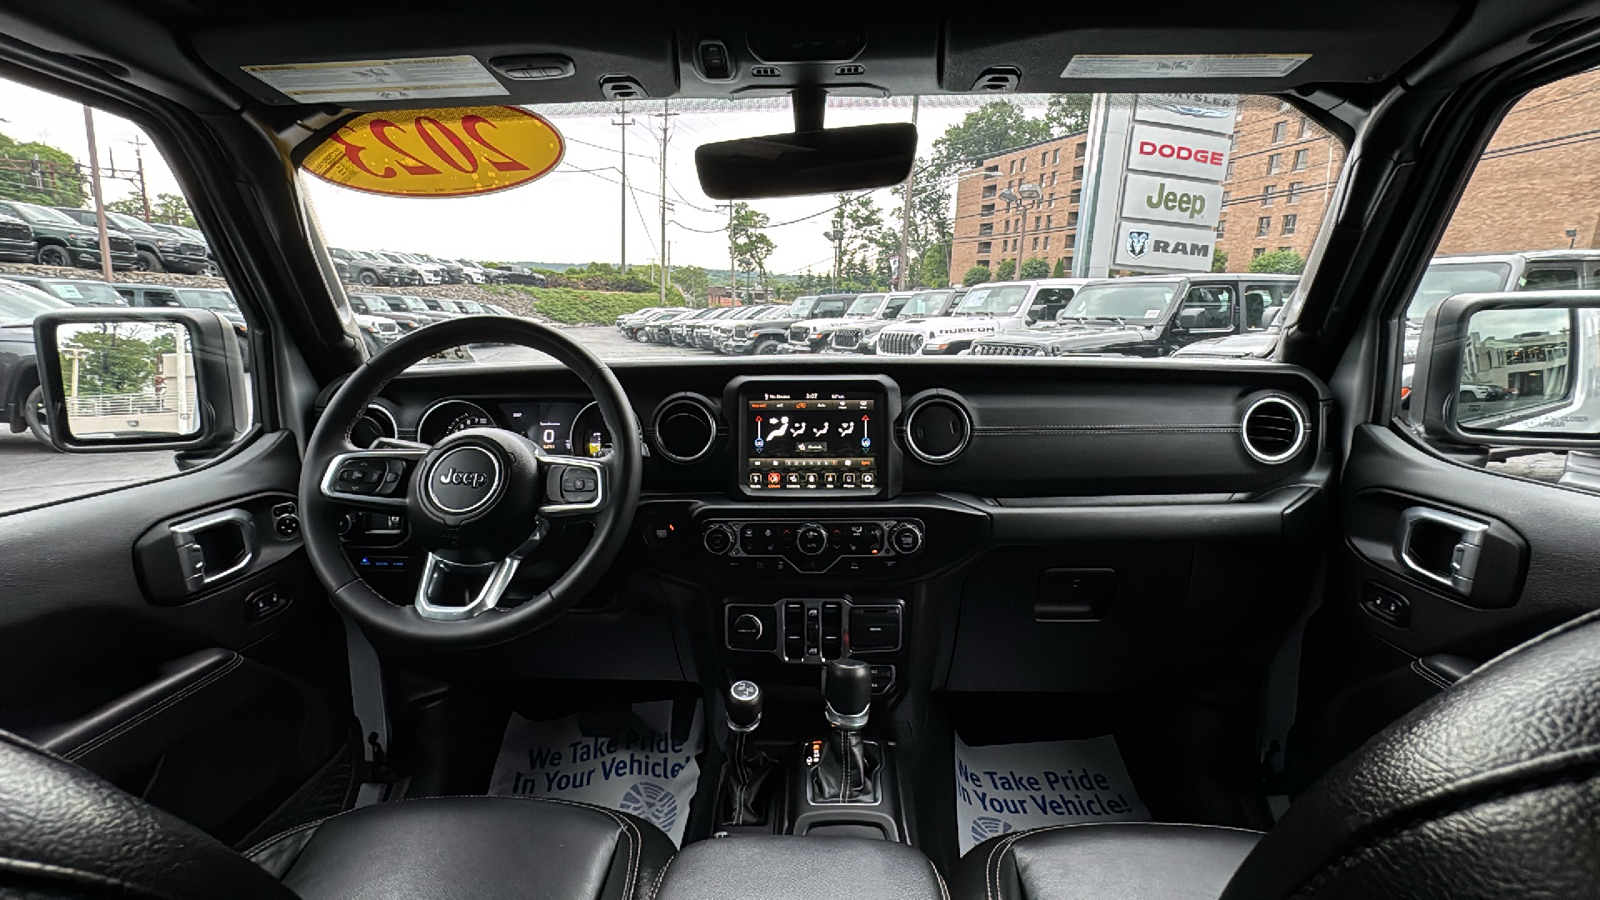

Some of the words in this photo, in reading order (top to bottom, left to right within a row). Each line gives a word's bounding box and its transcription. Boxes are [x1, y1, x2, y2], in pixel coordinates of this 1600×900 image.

[1138, 141, 1224, 166] DODGE
[1146, 183, 1206, 219] Jeep
[1152, 239, 1210, 257] RAM
[939, 326, 995, 334] RUBICON
[543, 429, 555, 443] 0
[440, 467, 487, 487] Jeep
[529, 748, 562, 769] We
[570, 736, 618, 764] Take
[626, 730, 684, 754] Pride
[512, 772, 535, 795] In
[545, 769, 595, 792] Your
[957, 757, 983, 787] We
[984, 771, 1042, 791] Take
[1043, 768, 1110, 791] Pride
[957, 776, 973, 805] In
[973, 789, 1028, 812] Your
[1029, 793, 1133, 816] Vehicle!
